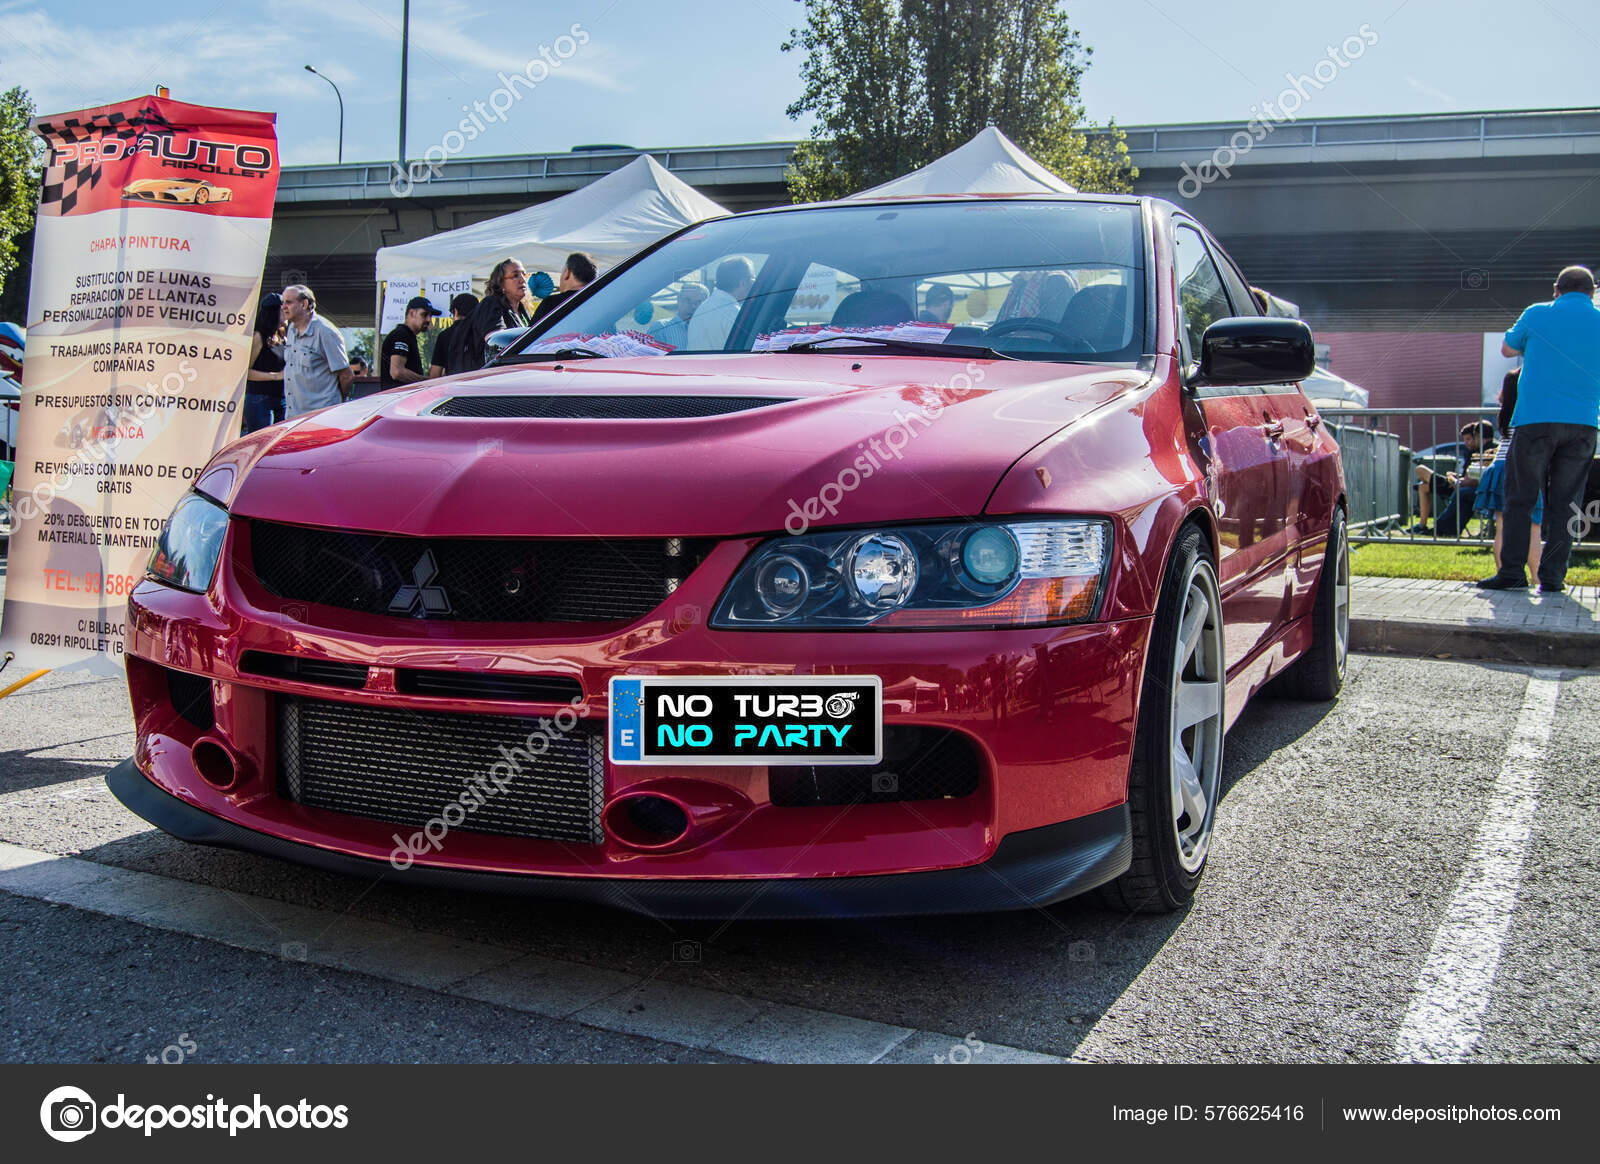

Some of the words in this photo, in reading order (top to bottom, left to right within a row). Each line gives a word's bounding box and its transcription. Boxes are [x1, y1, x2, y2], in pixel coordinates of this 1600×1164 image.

[162, 160, 269, 178] RIPOLLET
[90, 236, 117, 252] CHAPA
[119, 236, 127, 249] Y
[129, 236, 191, 252] PINTURA
[76, 271, 133, 288] SUSTITUCION
[137, 271, 155, 283] DE
[159, 272, 211, 288] LUNAS
[432, 281, 470, 292] TICKETS
[70, 289, 124, 305] REPARACION
[128, 288, 143, 300] DE
[148, 289, 216, 307] LLANTAS
[43, 306, 133, 322] PERSONALIZACION
[137, 306, 154, 318] DE
[160, 308, 246, 325] VEHICULOS
[51, 342, 111, 357] TRABAJAMOS
[114, 342, 142, 355] PARA
[148, 342, 200, 359] TODAS
[203, 348, 232, 361] LAS
[94, 357, 155, 372] COMPAÑIAS
[35, 395, 113, 408] PRESUPUESTOS
[115, 394, 132, 407] SIN
[136, 395, 236, 413] COMPROMISO
[35, 462, 95, 475] REVISIONES
[97, 463, 116, 476] CON
[119, 464, 153, 478] MANO
[158, 465, 177, 478] DE
[97, 481, 132, 494] GRATIS
[44, 513, 65, 527] 20%
[68, 514, 122, 529] DESCUENTO
[125, 517, 139, 530] EN
[38, 530, 88, 545] MATERIAL
[90, 533, 102, 545] DE
[43, 568, 80, 592] TEL:
[84, 571, 101, 594] 93
[106, 574, 134, 597] 586
[78, 619, 87, 632] C/
[30, 632, 61, 647] 08291
[64, 635, 110, 652] RIPOLLET
[657, 695, 713, 717] NO
[621, 729, 634, 747] E
[657, 724, 713, 747] NO
[734, 724, 852, 747] PARTY
